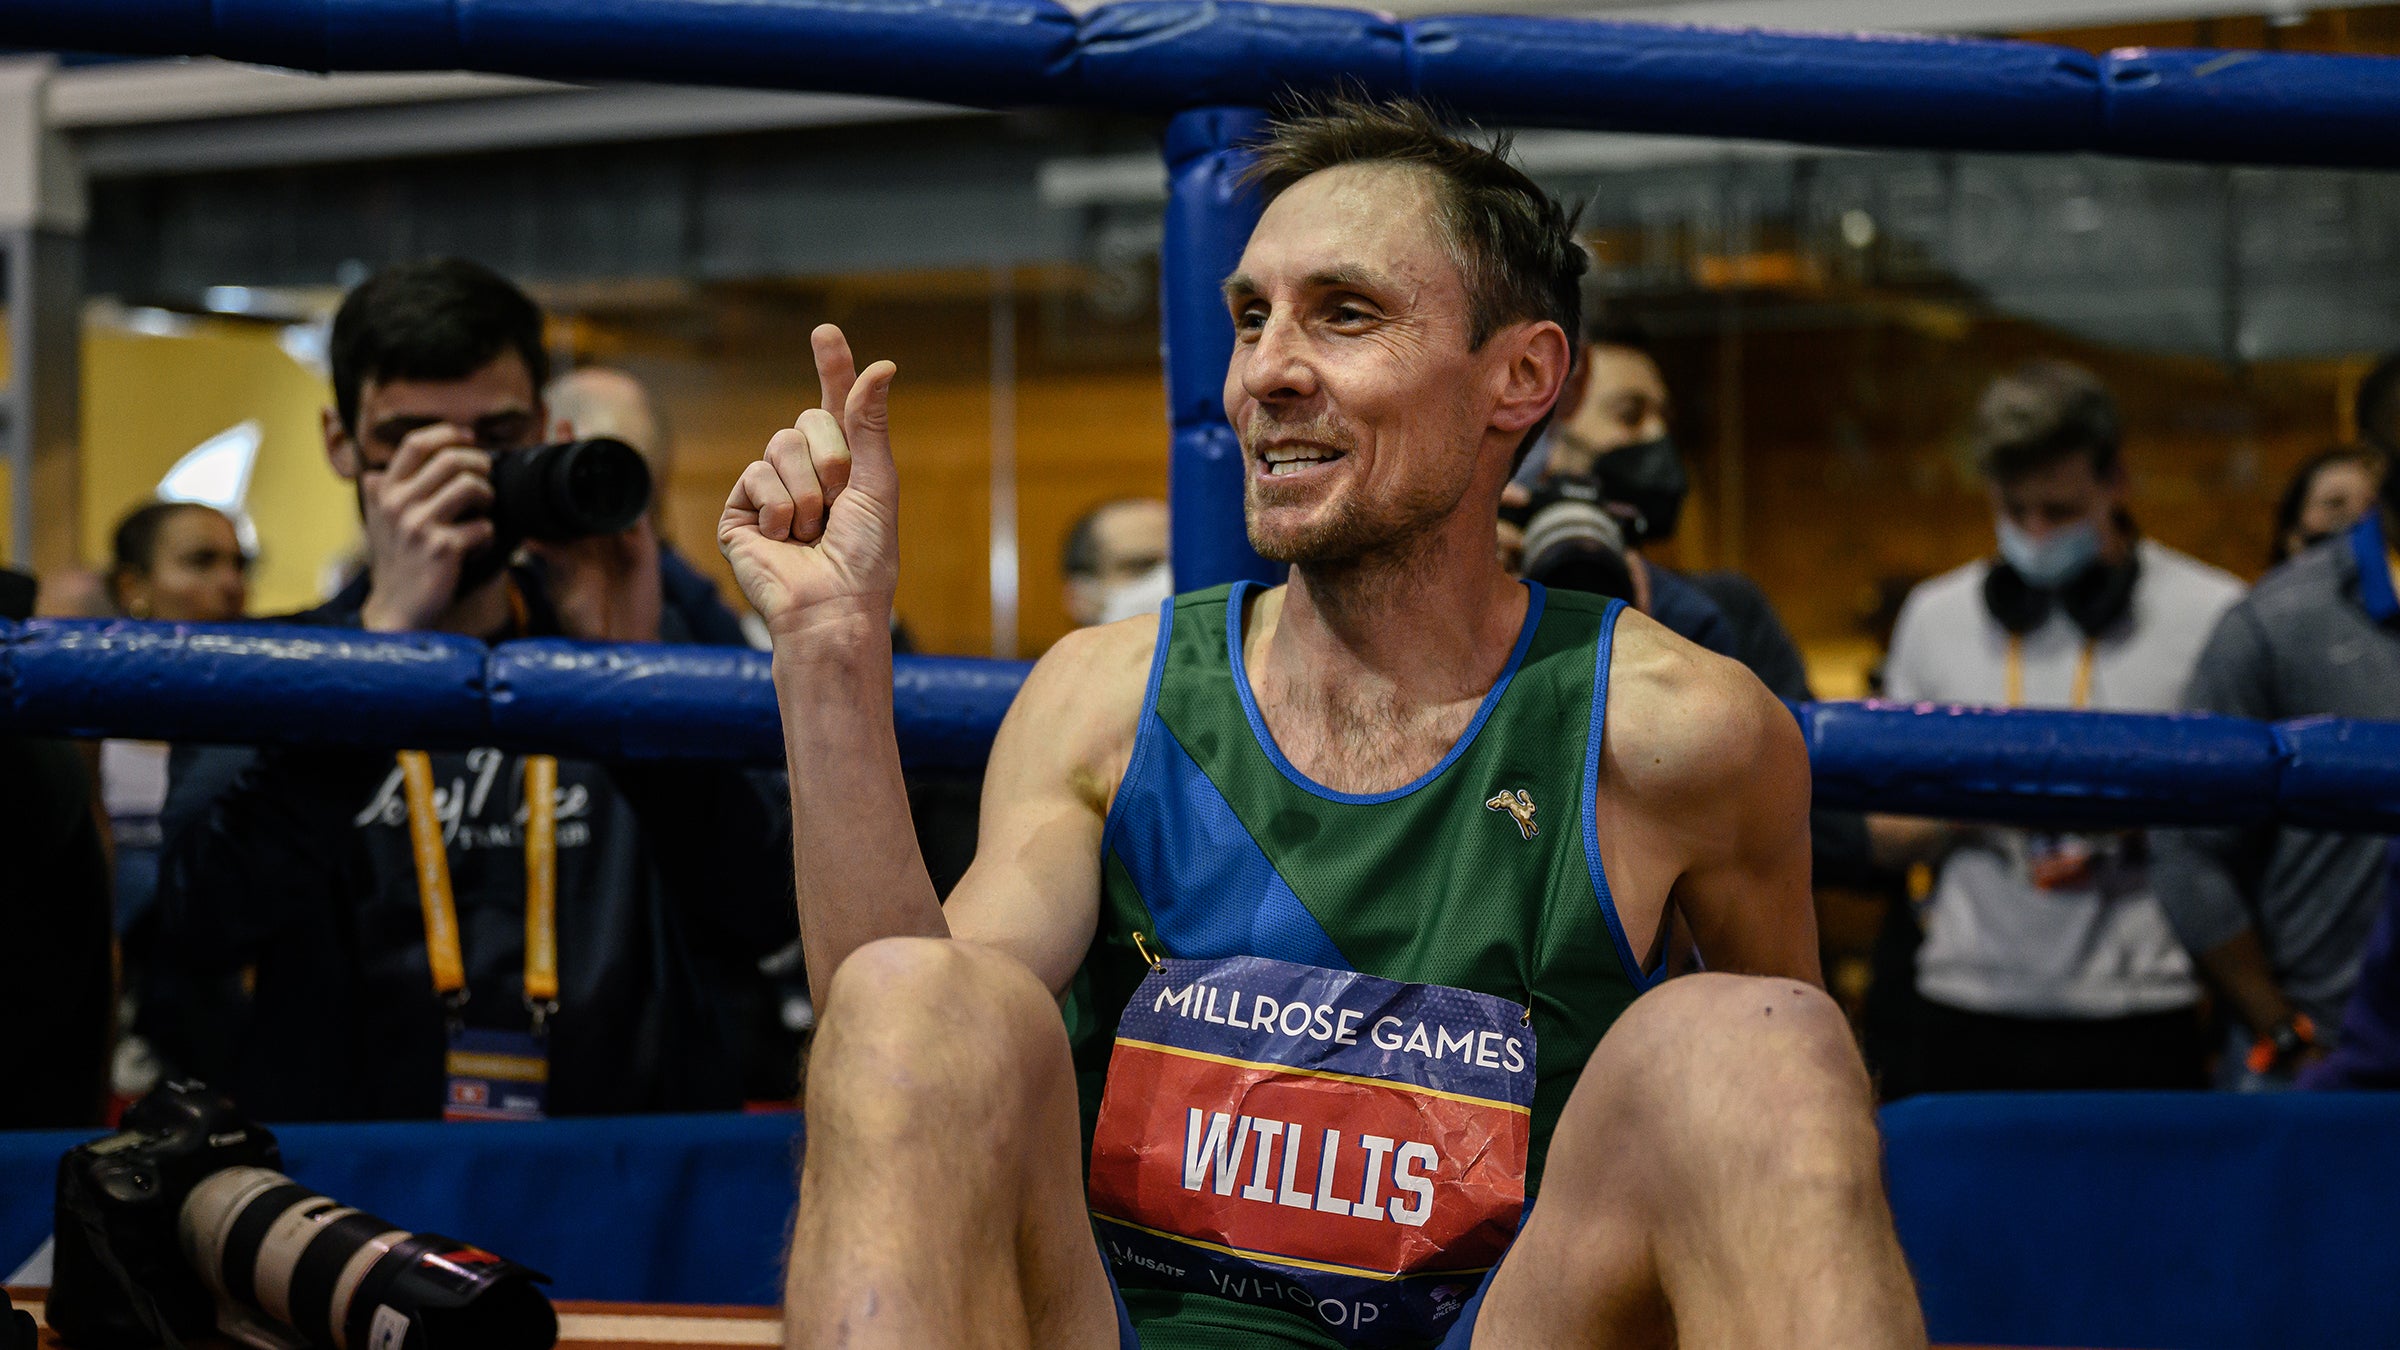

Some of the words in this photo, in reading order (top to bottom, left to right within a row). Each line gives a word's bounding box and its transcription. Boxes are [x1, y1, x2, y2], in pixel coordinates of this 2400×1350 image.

[1153, 983, 1364, 1046] MILLROSE
[1371, 1015, 1525, 1073] GAMES
[1181, 1107, 1440, 1227] WILLIS
[1134, 1254, 1186, 1278] USATF
[1209, 1269, 1379, 1330] WHOOP
